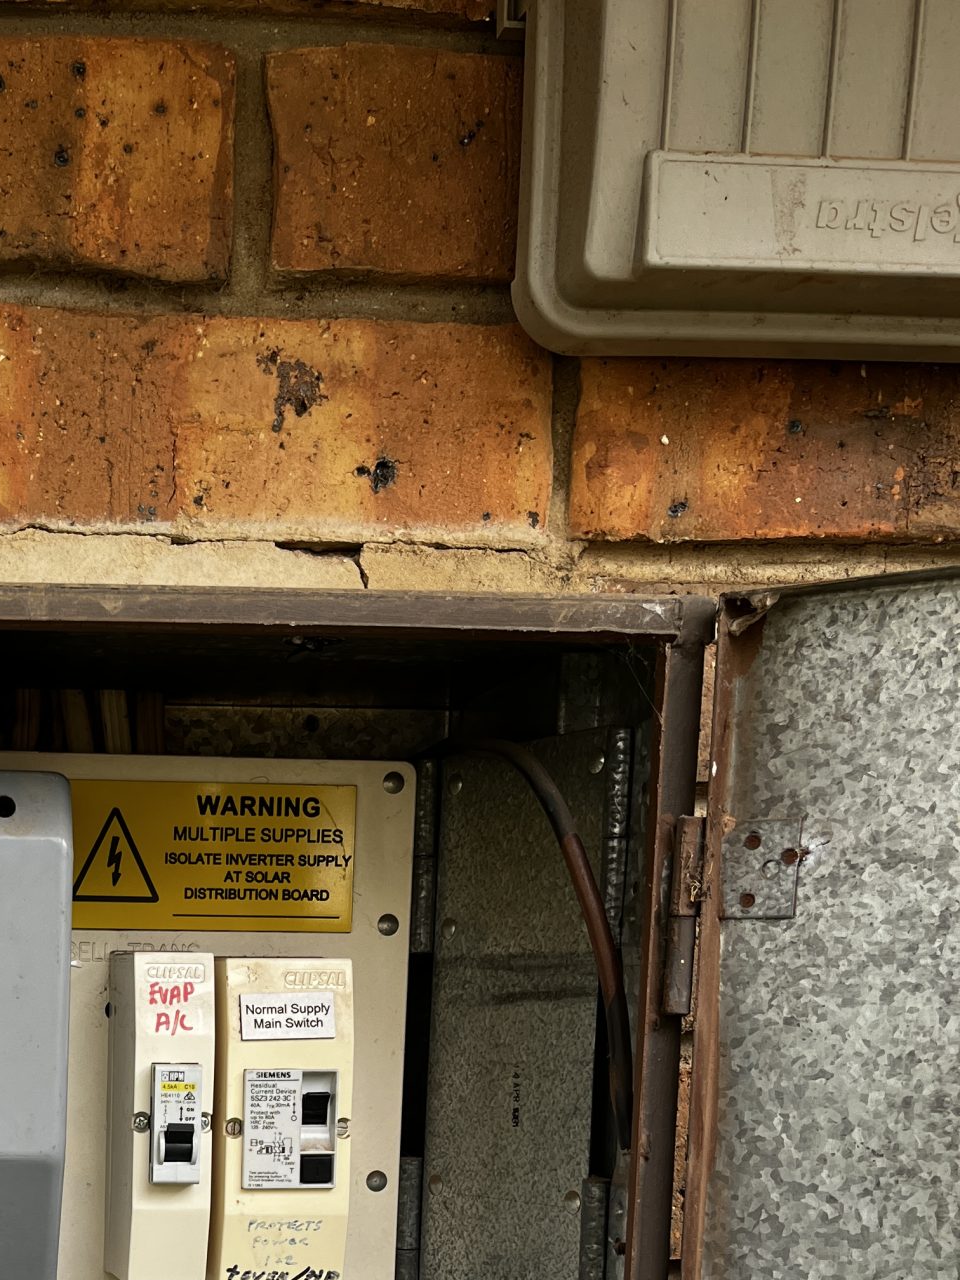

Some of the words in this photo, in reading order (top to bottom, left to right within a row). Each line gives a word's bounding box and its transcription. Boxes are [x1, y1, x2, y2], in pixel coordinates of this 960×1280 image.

[815, 192, 960, 243] elstra
[197, 795, 320, 818] WARNING
[173, 827, 255, 843] MULTIPLE
[261, 828, 344, 844] SUPPLIES
[165, 852, 221, 866] ISOLATE
[226, 853, 294, 867] INVERTER
[298, 854, 352, 868] SUPPLY
[224, 871, 241, 883] AT
[245, 871, 290, 884] SOLAR
[184, 888, 278, 901] DISTRIBUTION
[282, 889, 330, 902] BOARD
[147, 965, 202, 980] CLIPSAL
[284, 970, 346, 989] CLIPSAL
[149, 981, 195, 1006] EVAP
[246, 1003, 287, 1015] Normal
[290, 1003, 330, 1016] Supply
[155, 1009, 194, 1036] A/C
[254, 1018, 282, 1029] Main
[285, 1017, 323, 1029] Switch
[255, 1071, 292, 1079] SIEMENS
